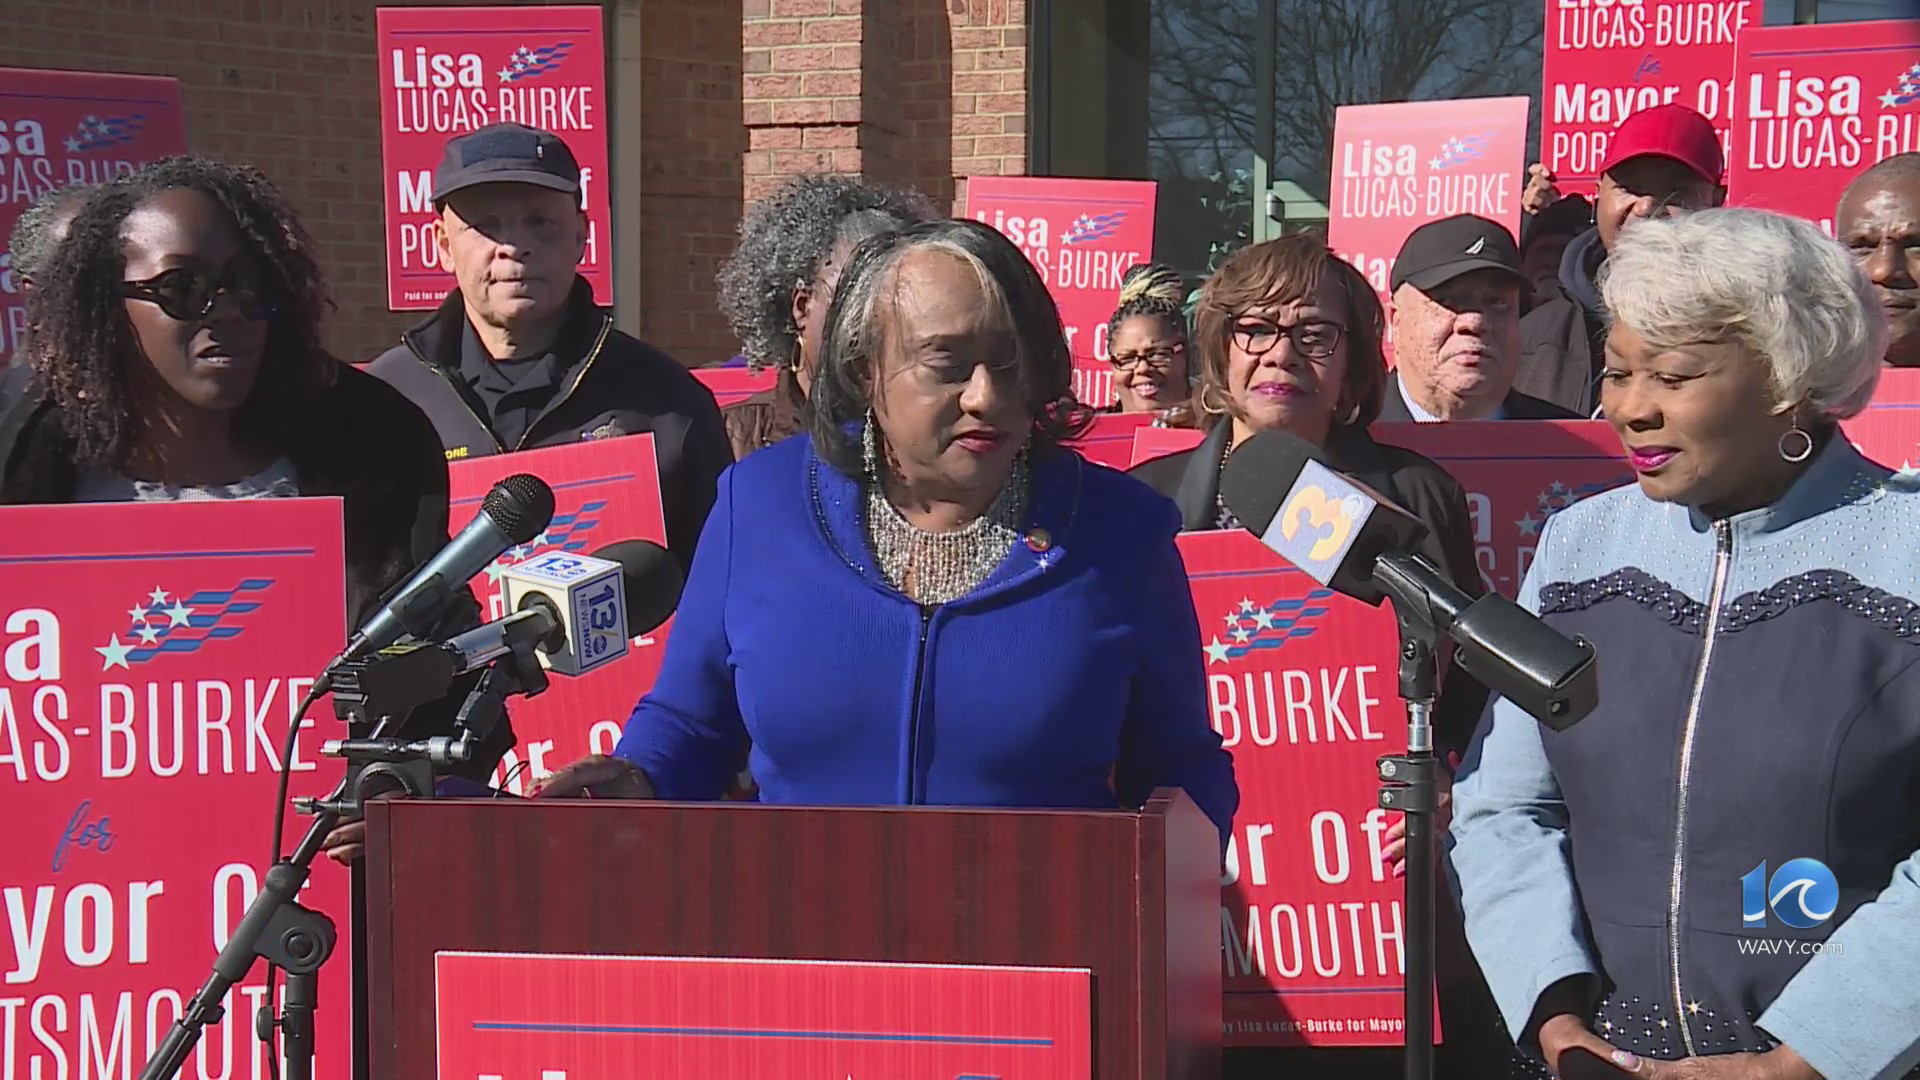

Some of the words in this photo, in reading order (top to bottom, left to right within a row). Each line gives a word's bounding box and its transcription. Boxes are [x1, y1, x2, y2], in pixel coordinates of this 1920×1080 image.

[1559, 1, 1750, 49] LUCAS-BURKE
[393, 47, 483, 88] Lisa
[397, 86, 593, 132] LUCAS-BURKE
[1554, 83, 1680, 127] Mayor
[1749, 70, 1861, 118] Lisa
[1343, 140, 1417, 178] Lisa
[1342, 173, 1510, 218] LUCAS-BURKE
[1281, 485, 1353, 561] 3
[1310, 808, 1388, 884] Of
[1347, 1018, 1365, 1031] for
